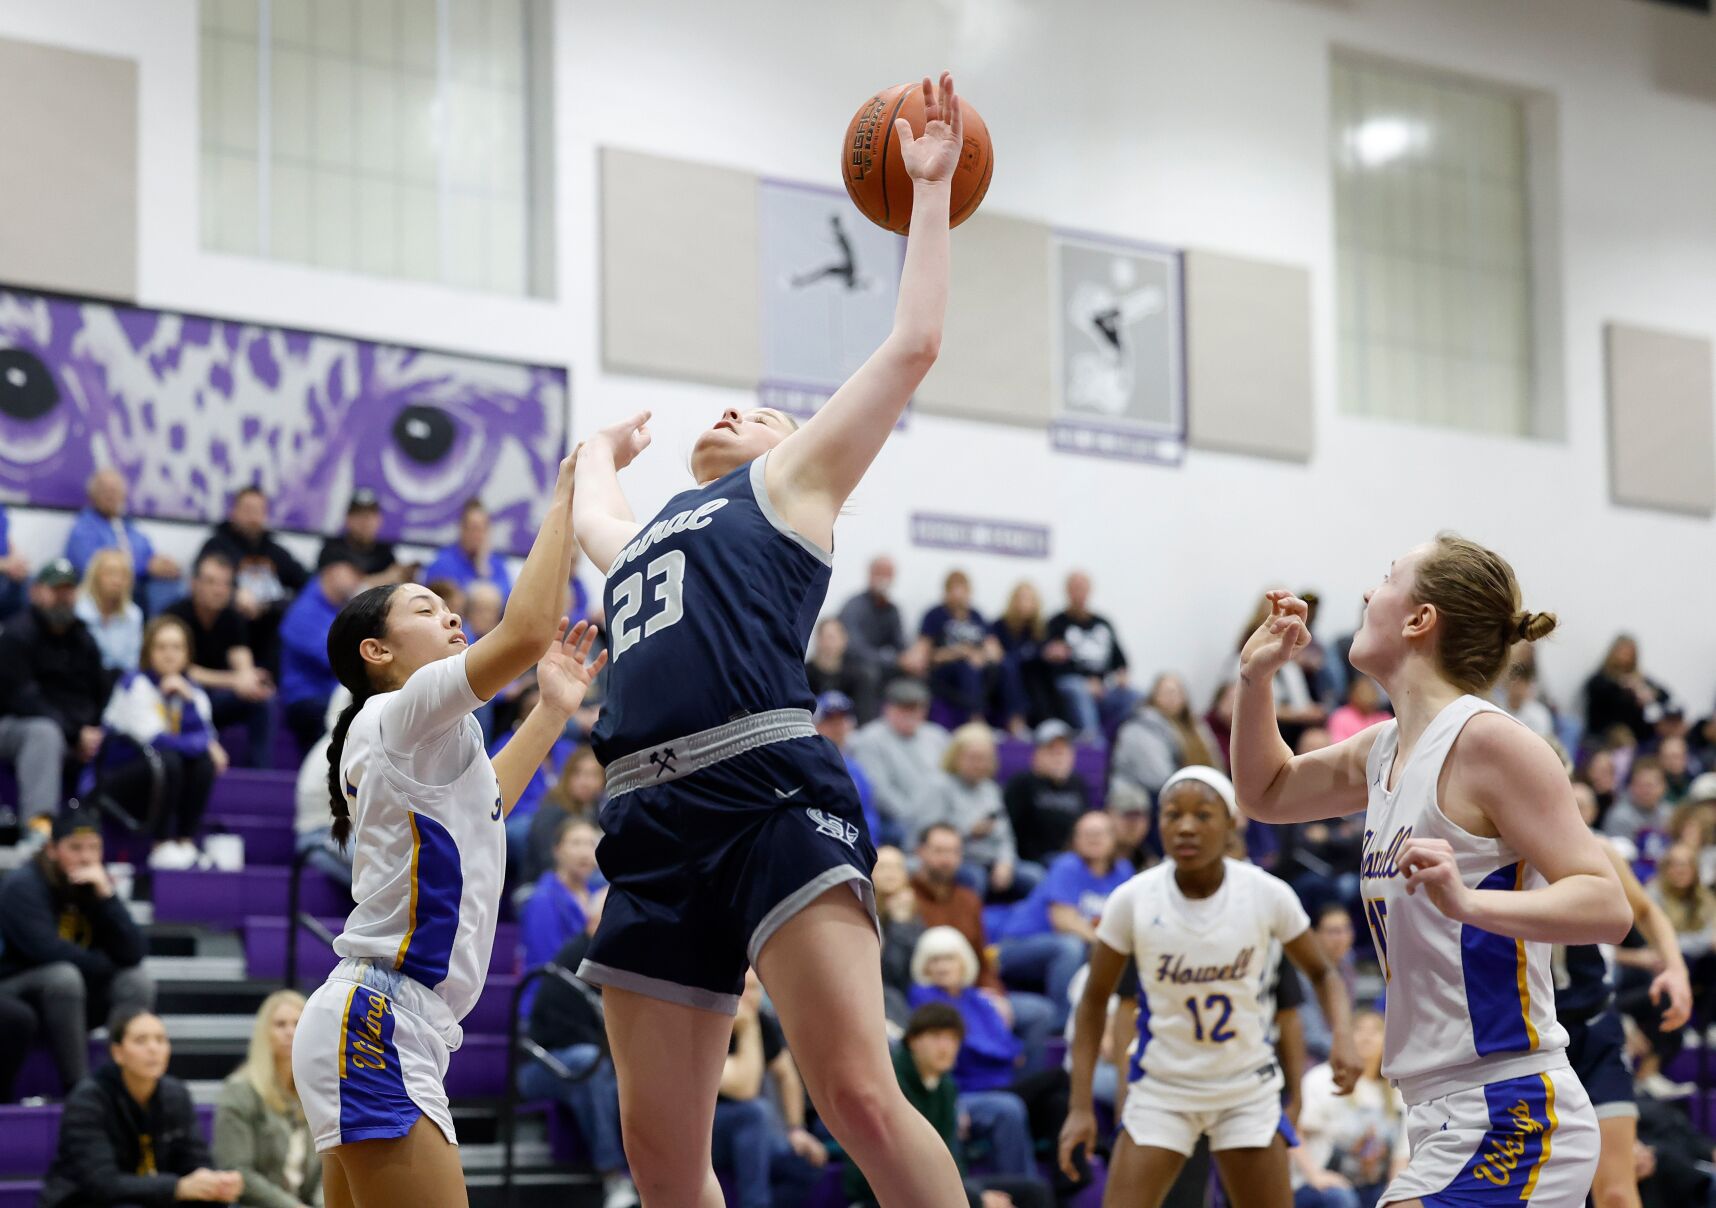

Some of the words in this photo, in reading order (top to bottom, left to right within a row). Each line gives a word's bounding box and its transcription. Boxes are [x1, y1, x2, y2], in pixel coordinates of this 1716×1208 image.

[853, 97, 881, 180] LEGACY
[606, 498, 729, 579] entral
[611, 550, 685, 664] 23
[1157, 946, 1255, 984] Howell
[1185, 993, 1236, 1042] 12
[1473, 1099, 1544, 1186] Vikigs
